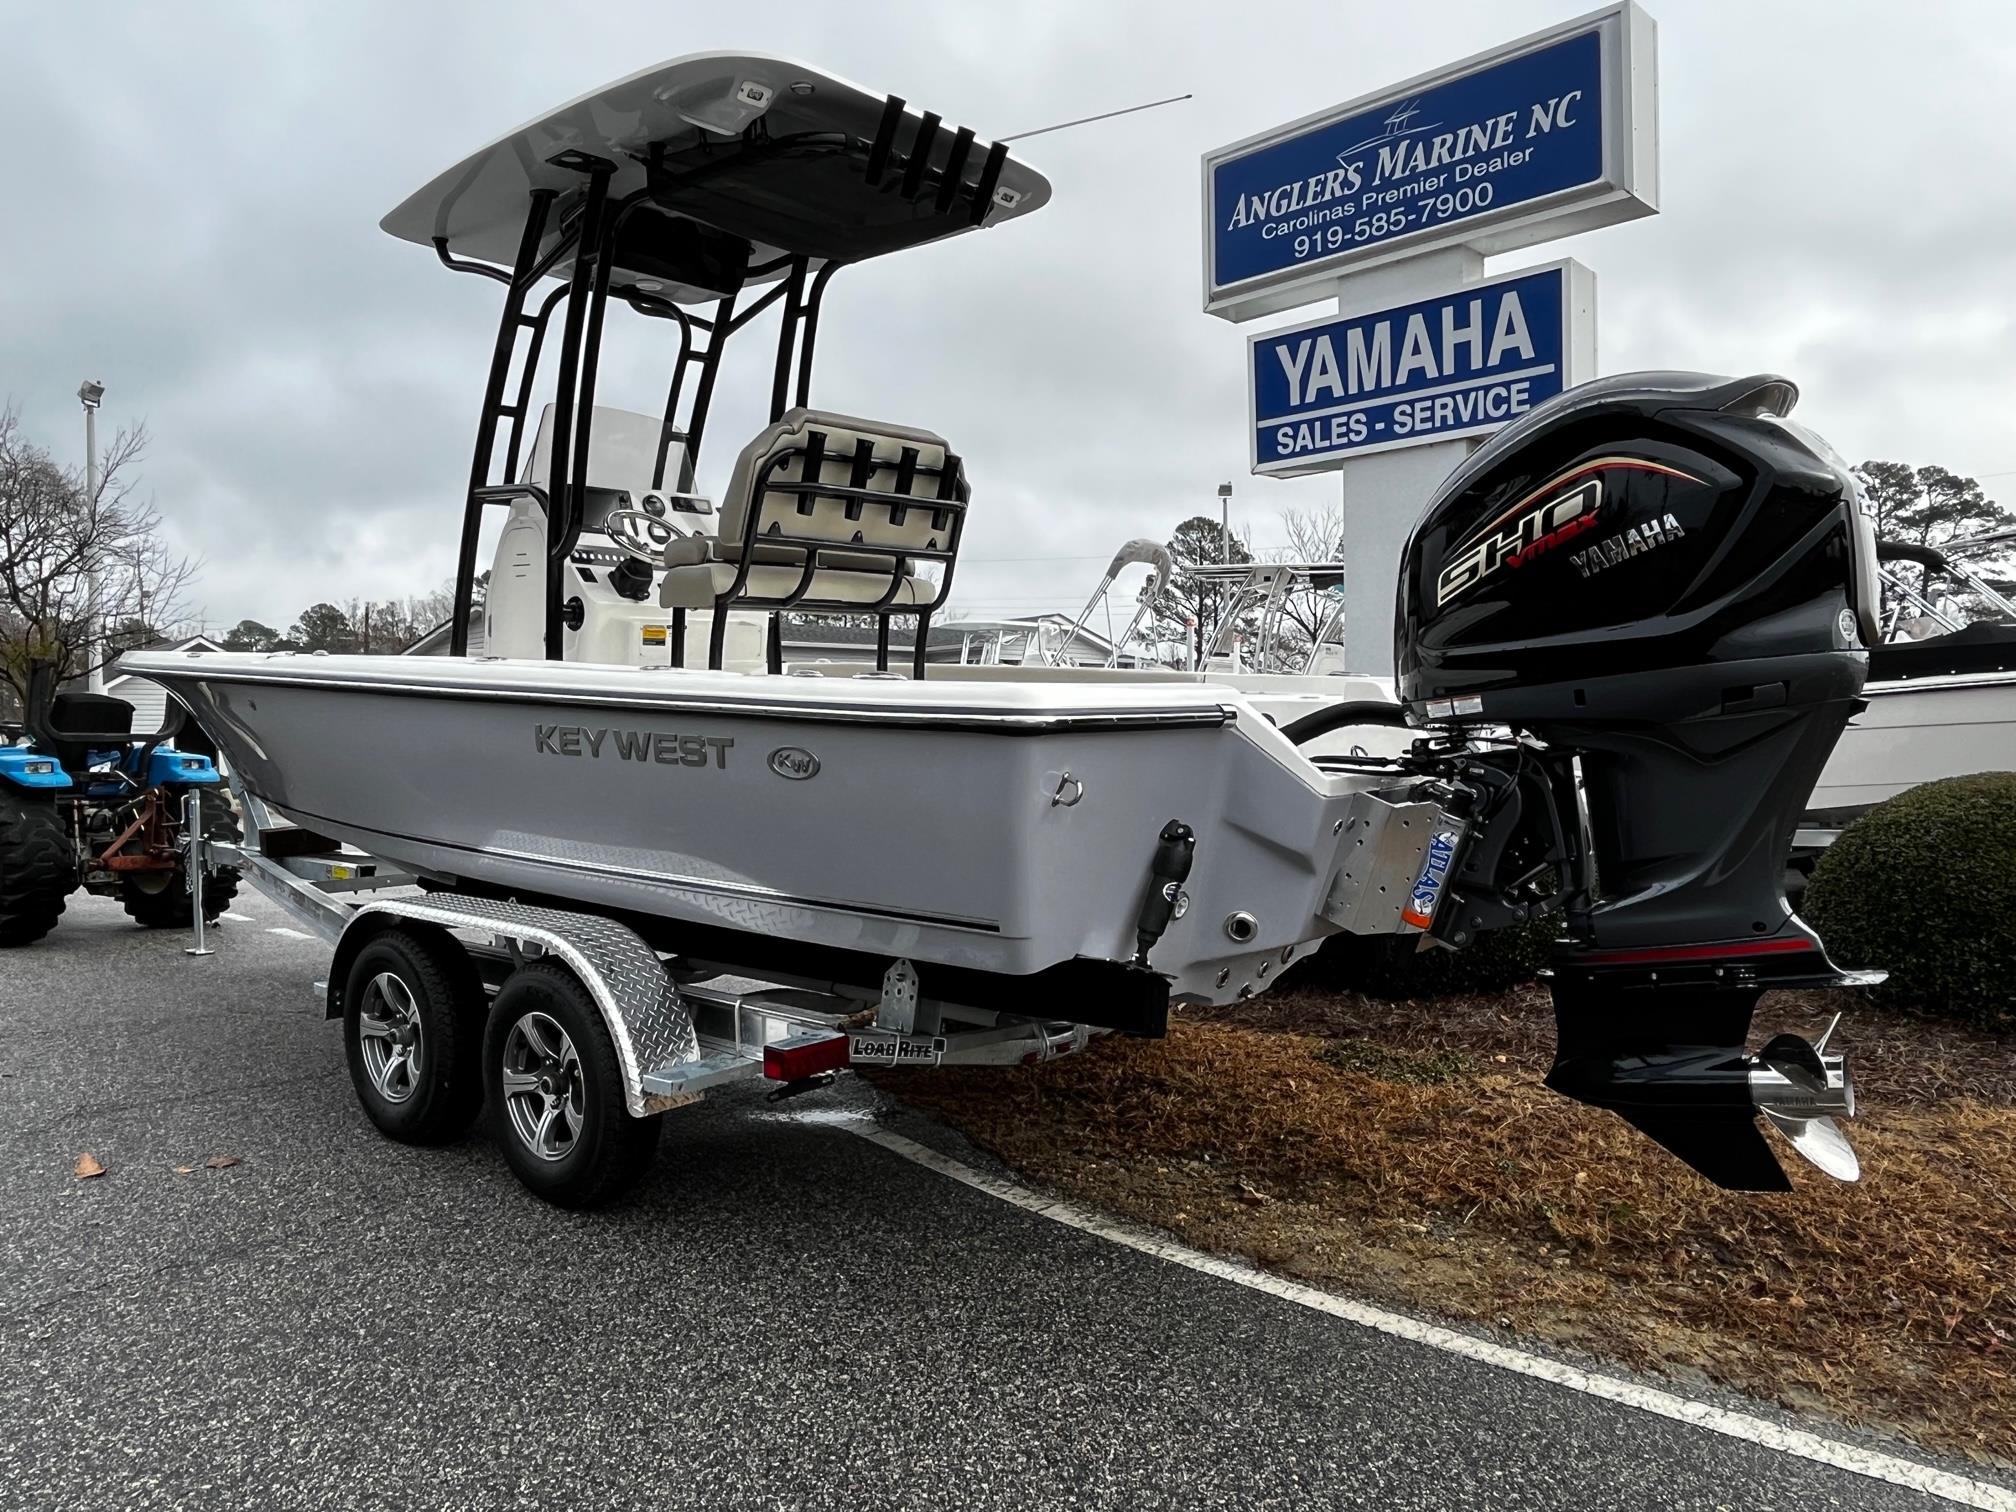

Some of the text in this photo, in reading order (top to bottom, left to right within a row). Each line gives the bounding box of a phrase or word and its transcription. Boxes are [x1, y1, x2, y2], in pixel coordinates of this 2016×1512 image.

[1227, 90, 1581, 231] ANGLERS MARINE NC
[1261, 144, 1535, 241] Carolinas Premier Dealer
[1293, 181, 1494, 259] 919-585-7900
[1275, 290, 1536, 407] YAMAHA
[1276, 412, 1368, 455] SALES
[1392, 380, 1531, 434] SERVICE
[1437, 479, 1602, 608] SHO
[1569, 512, 1686, 578] YAMAHA
[534, 723, 735, 770] KEY WEST
[777, 752, 813, 774] KW
[852, 1038, 933, 1060] LOAD RITE
